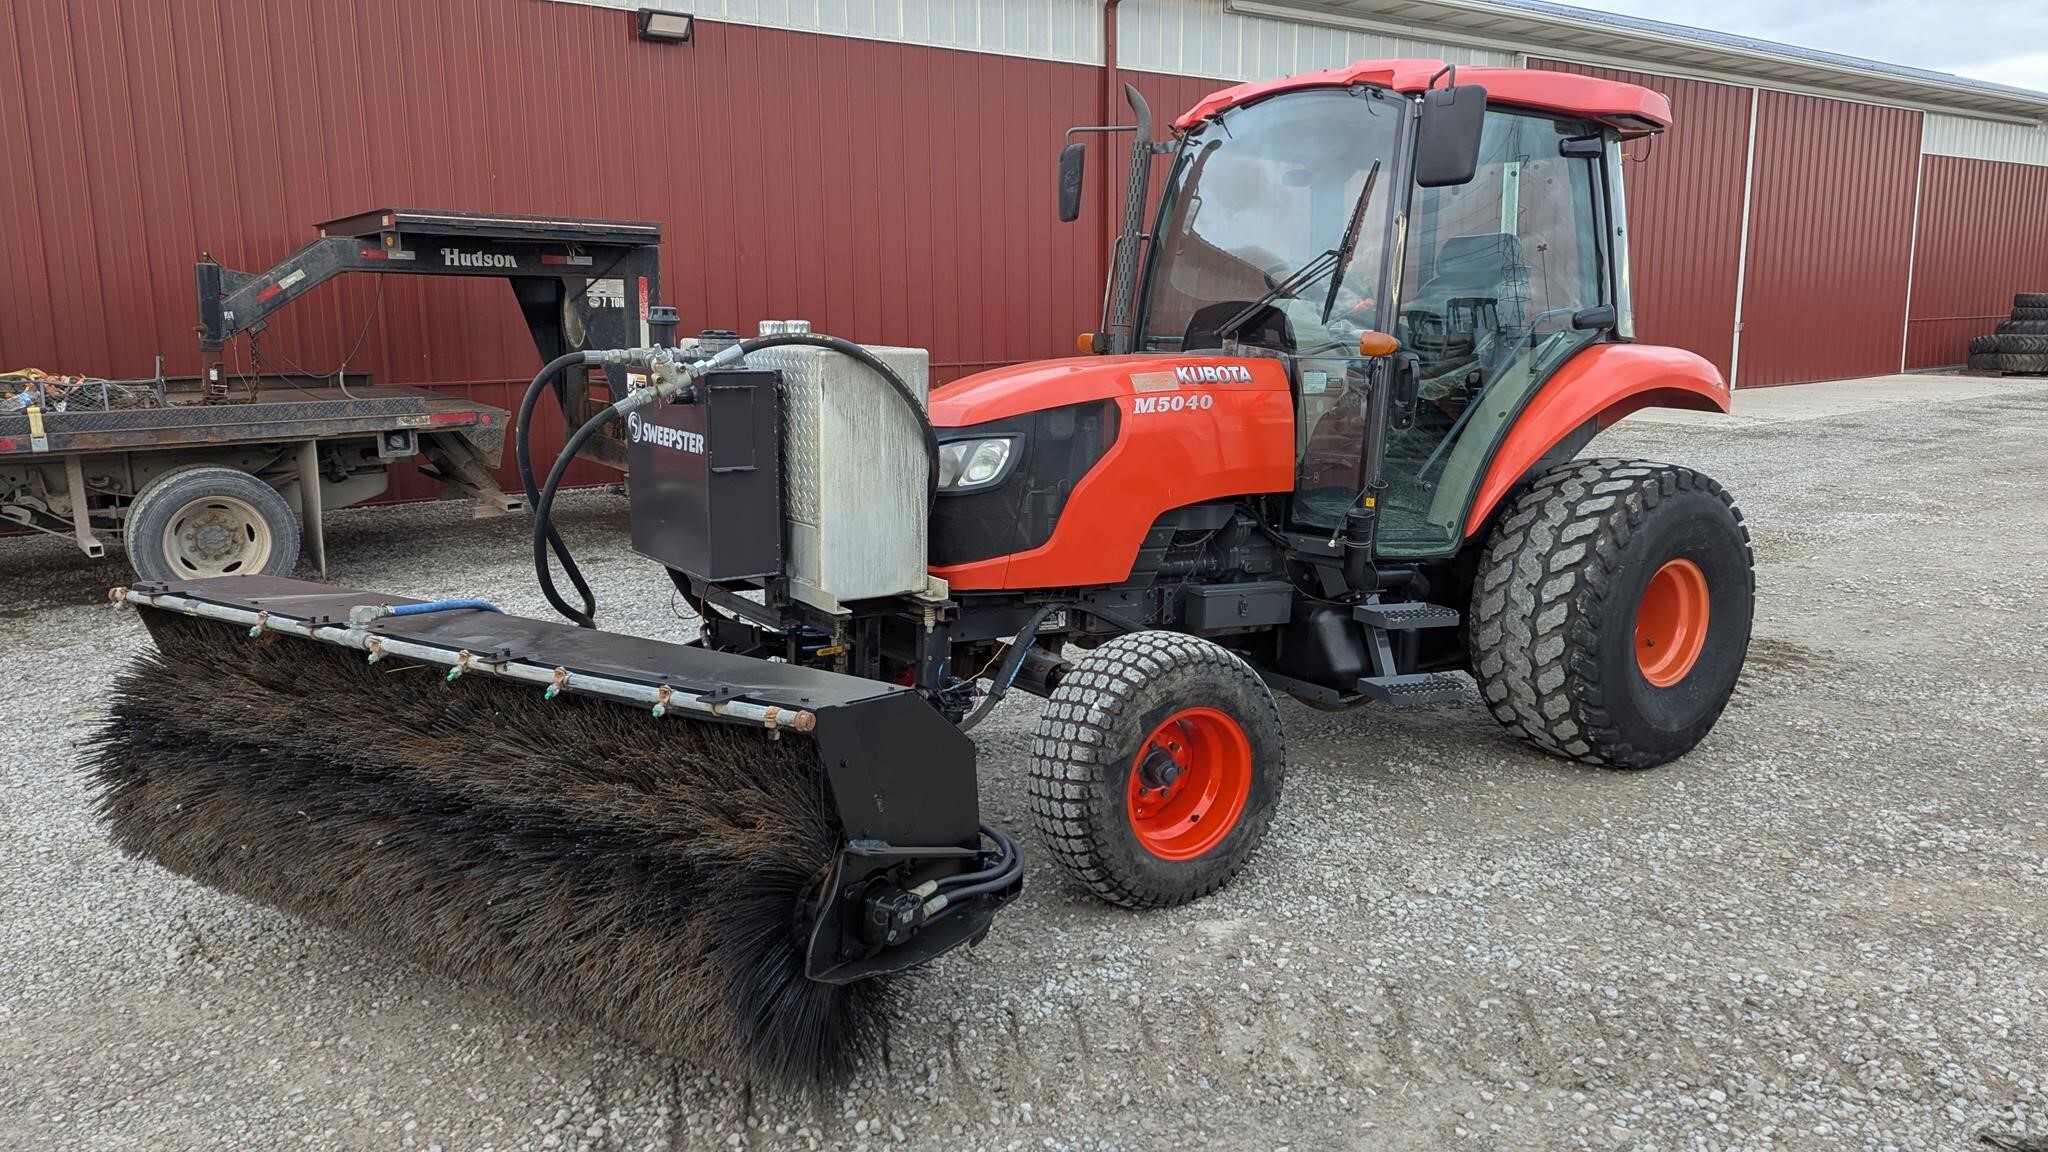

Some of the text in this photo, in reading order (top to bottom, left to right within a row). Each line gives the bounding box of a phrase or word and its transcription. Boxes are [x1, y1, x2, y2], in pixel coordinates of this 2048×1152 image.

[440, 247, 518, 269] Hudson
[602, 297, 625, 308] 7 TON
[1175, 365, 1253, 385] KUBOTA
[1132, 394, 1214, 416] M5040
[643, 422, 704, 456] SWEEPSTER
